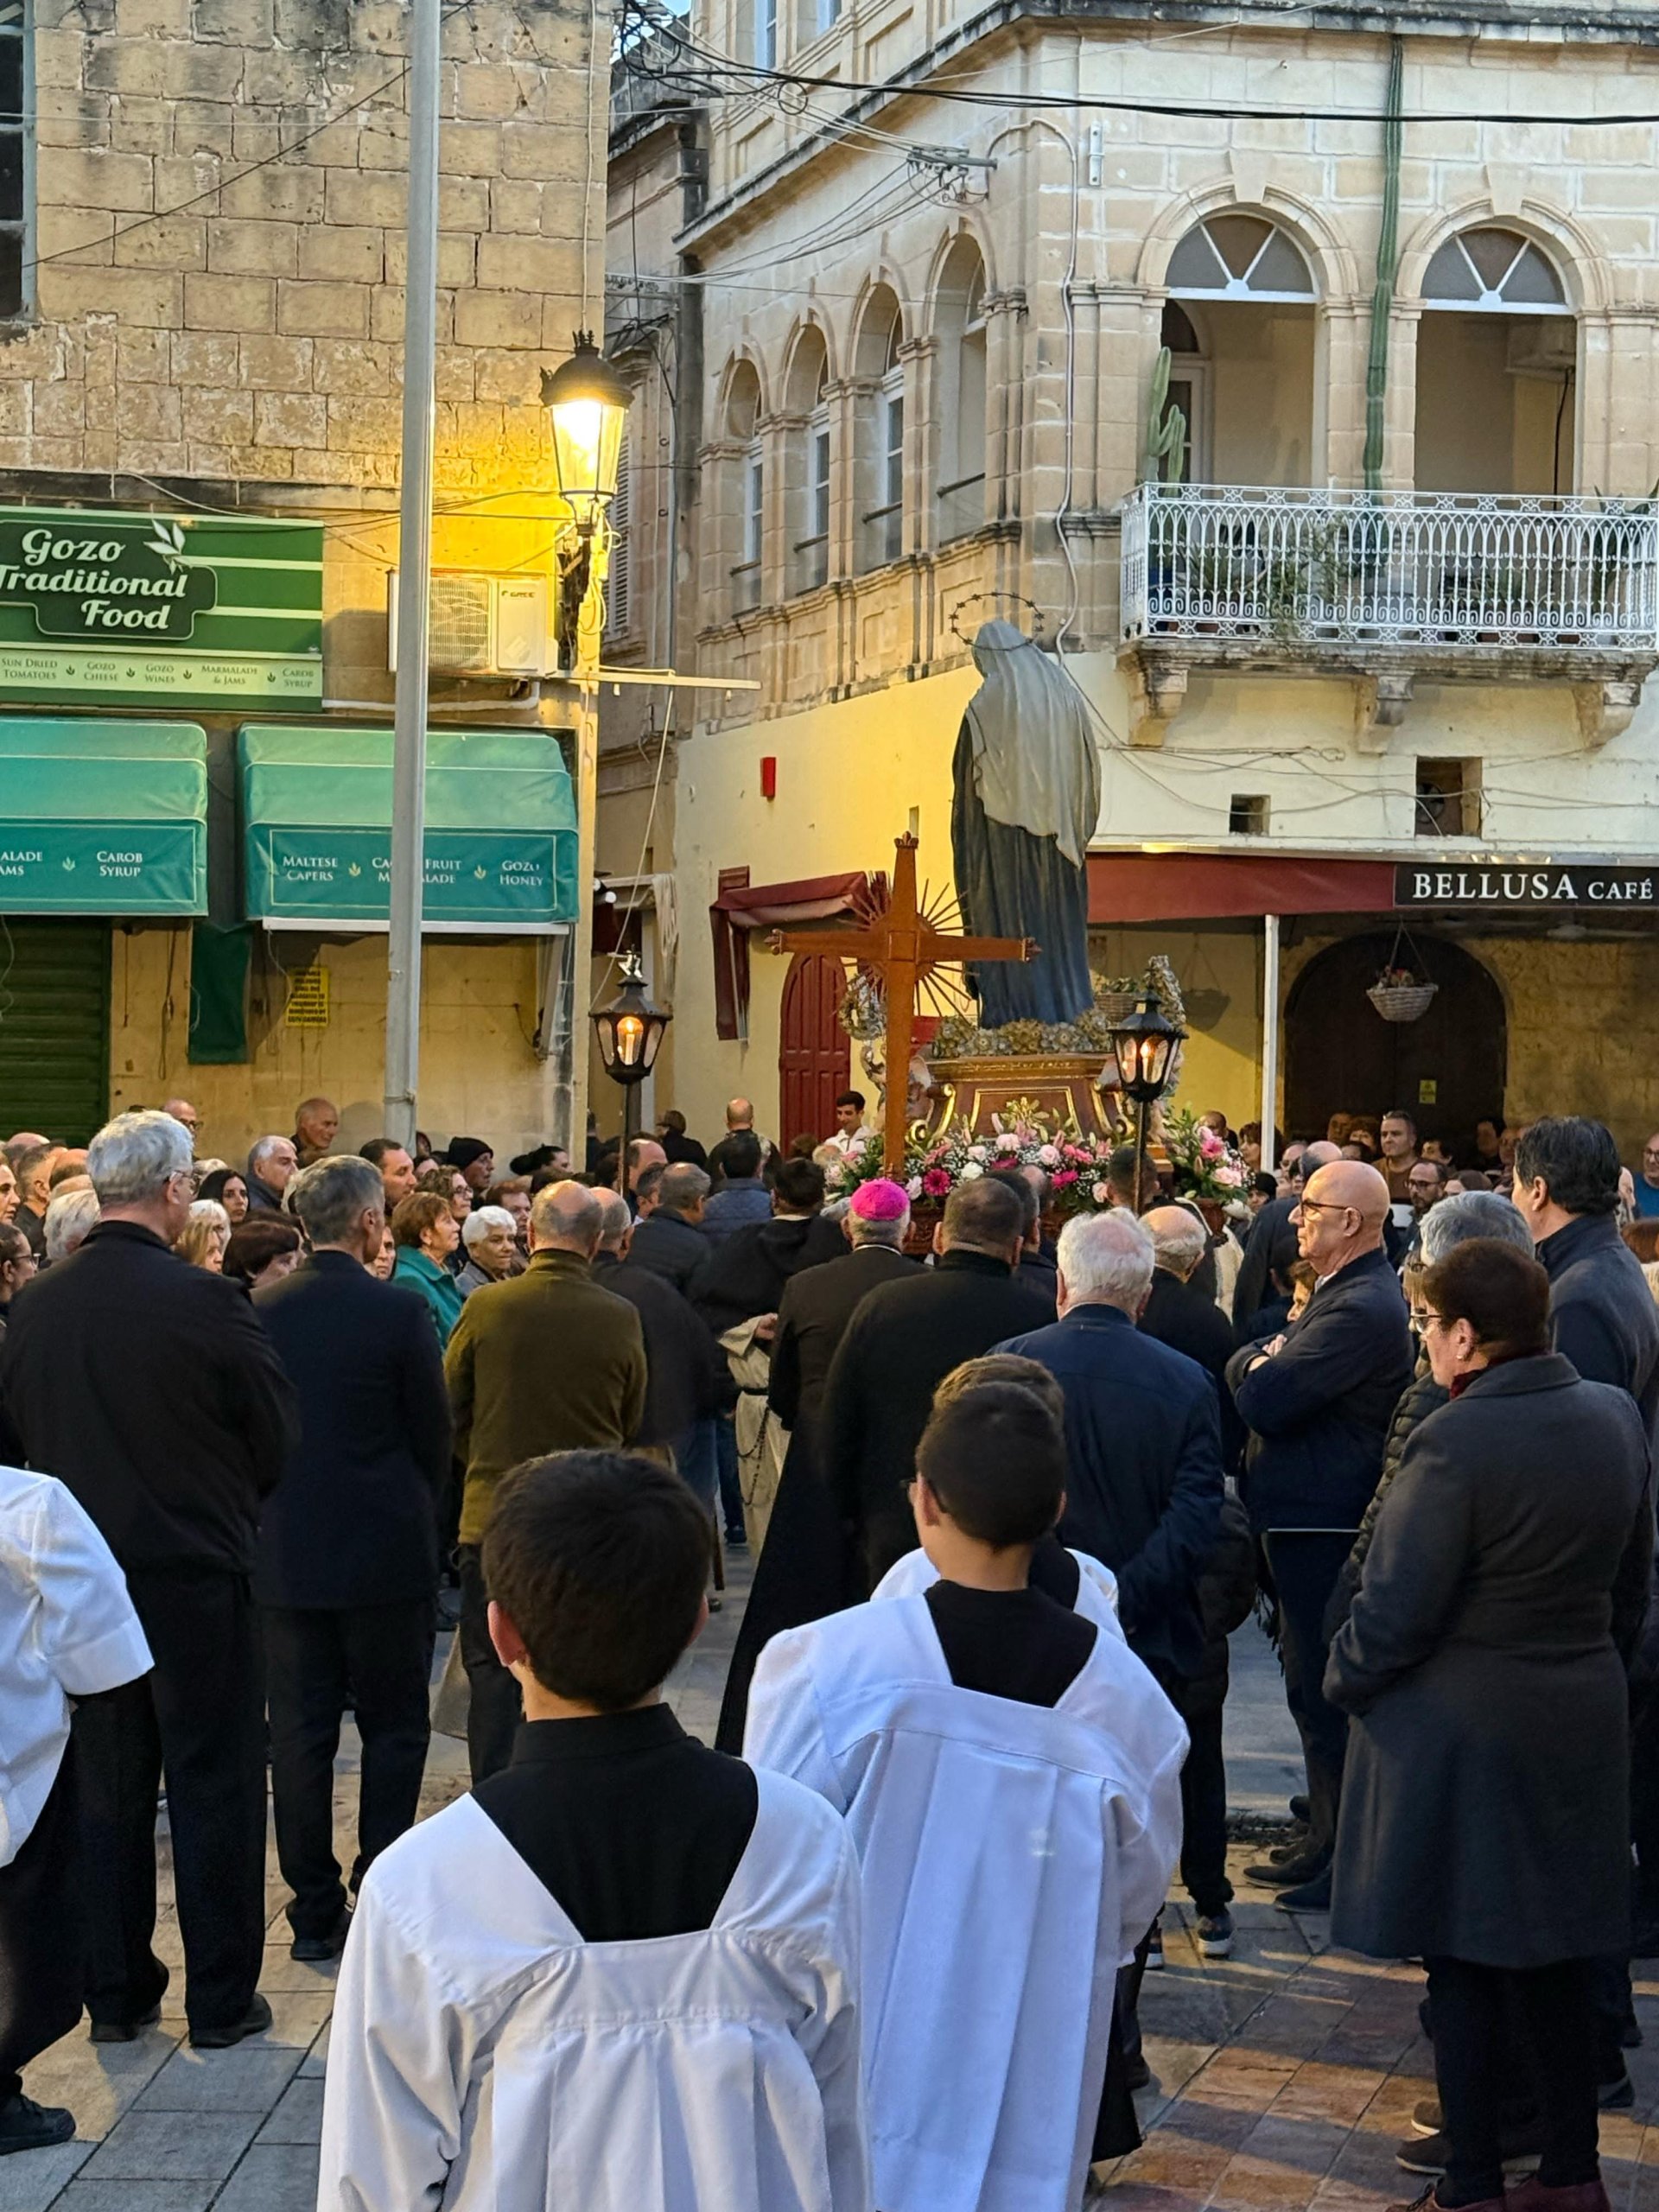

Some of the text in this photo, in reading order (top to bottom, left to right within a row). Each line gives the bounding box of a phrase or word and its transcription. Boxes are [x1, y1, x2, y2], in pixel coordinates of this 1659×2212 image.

[22, 528, 126, 566] Gozo
[0, 564, 188, 598] Traditional
[81, 600, 171, 630] Food
[2, 658, 58, 668] SUN DRIED
[146, 663, 175, 673] GOZO
[3, 669, 57, 680] TOMATOES
[144, 674, 175, 684] WINES
[97, 850, 143, 862] CAROB
[283, 855, 338, 868] MALTESE
[425, 858, 462, 870] FRUIT
[501, 860, 540, 872] GOZO
[99, 864, 141, 877] SYRUP
[287, 869, 334, 881] CAPERS
[499, 874, 543, 887] HONEY
[1412, 873, 1653, 900] BELLUSA CAFÉ
